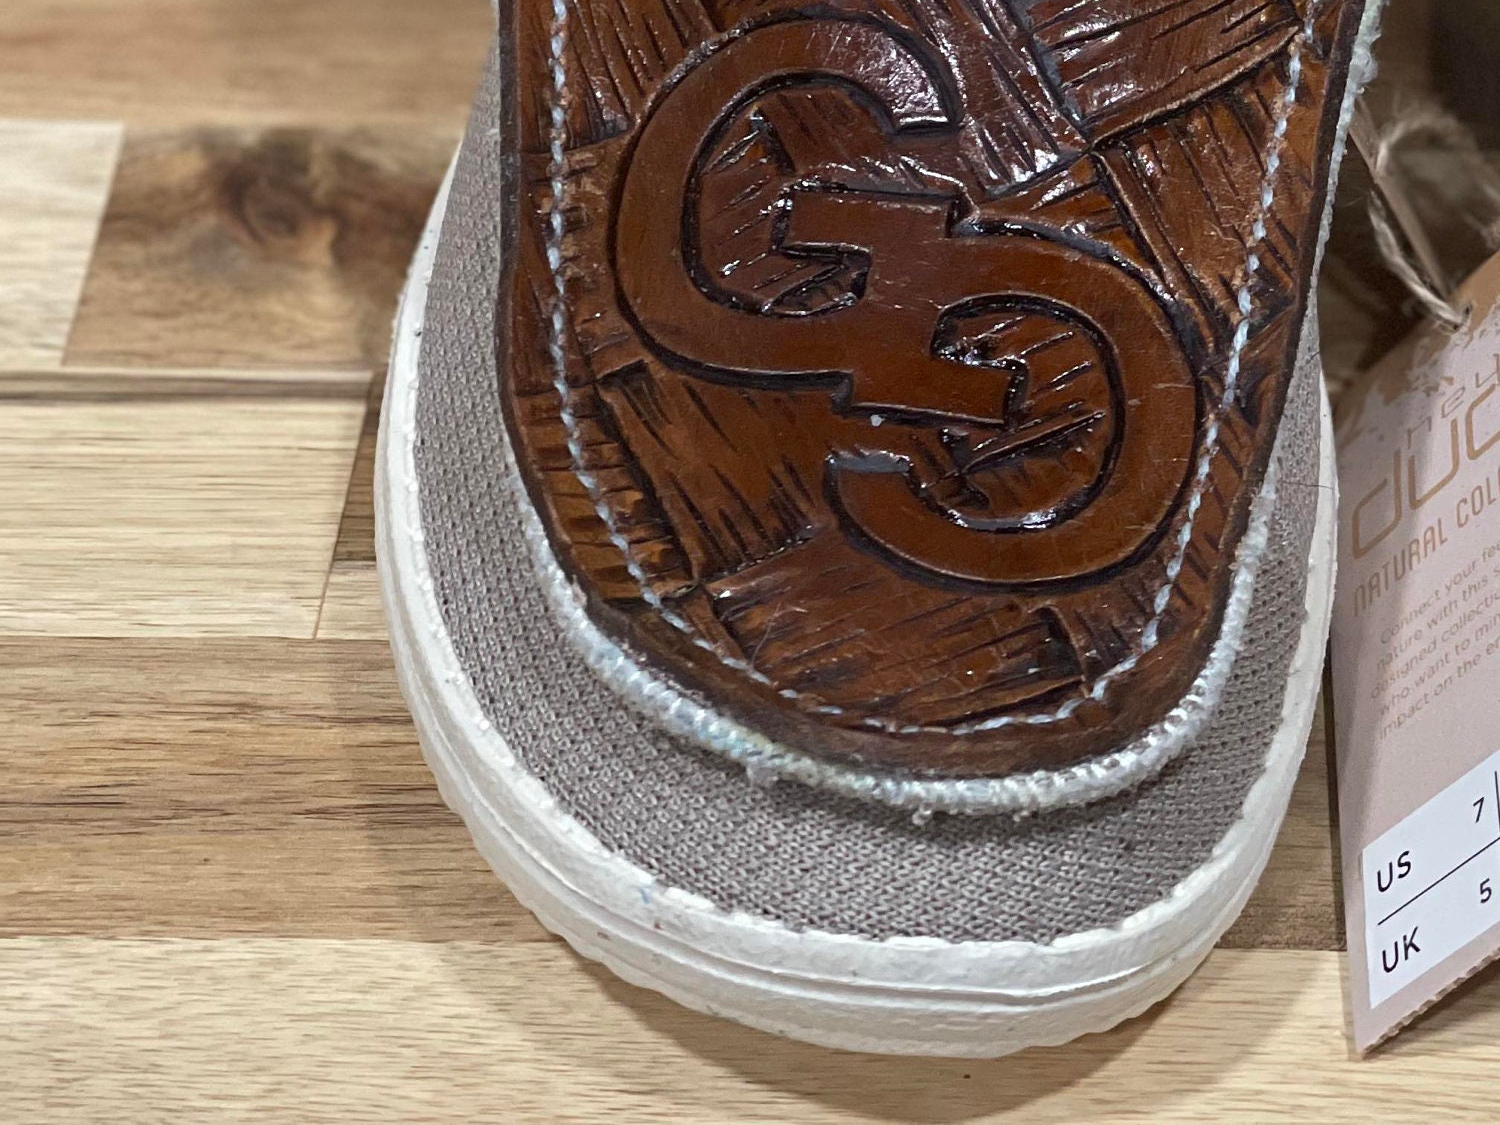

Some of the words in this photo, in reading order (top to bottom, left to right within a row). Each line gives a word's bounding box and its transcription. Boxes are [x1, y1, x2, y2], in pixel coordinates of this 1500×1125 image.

[1353, 517, 1449, 618] NATURAL
[1380, 588, 1441, 644] Connect
[1445, 561, 1477, 599] your
[1371, 638, 1437, 699] designed
[1376, 630, 1422, 672] nature
[1427, 597, 1458, 630] with
[1462, 576, 1489, 602] this
[1379, 693, 1430, 741] impact
[1434, 675, 1454, 697] on
[1457, 652, 1481, 679] the
[1380, 685, 1409, 717] who
[1414, 653, 1451, 686] want
[1454, 637, 1471, 657] to
[1376, 850, 1412, 893] US
[1472, 796, 1486, 824] 7
[1381, 926, 1421, 974] UK
[1479, 878, 1493, 904] 5
